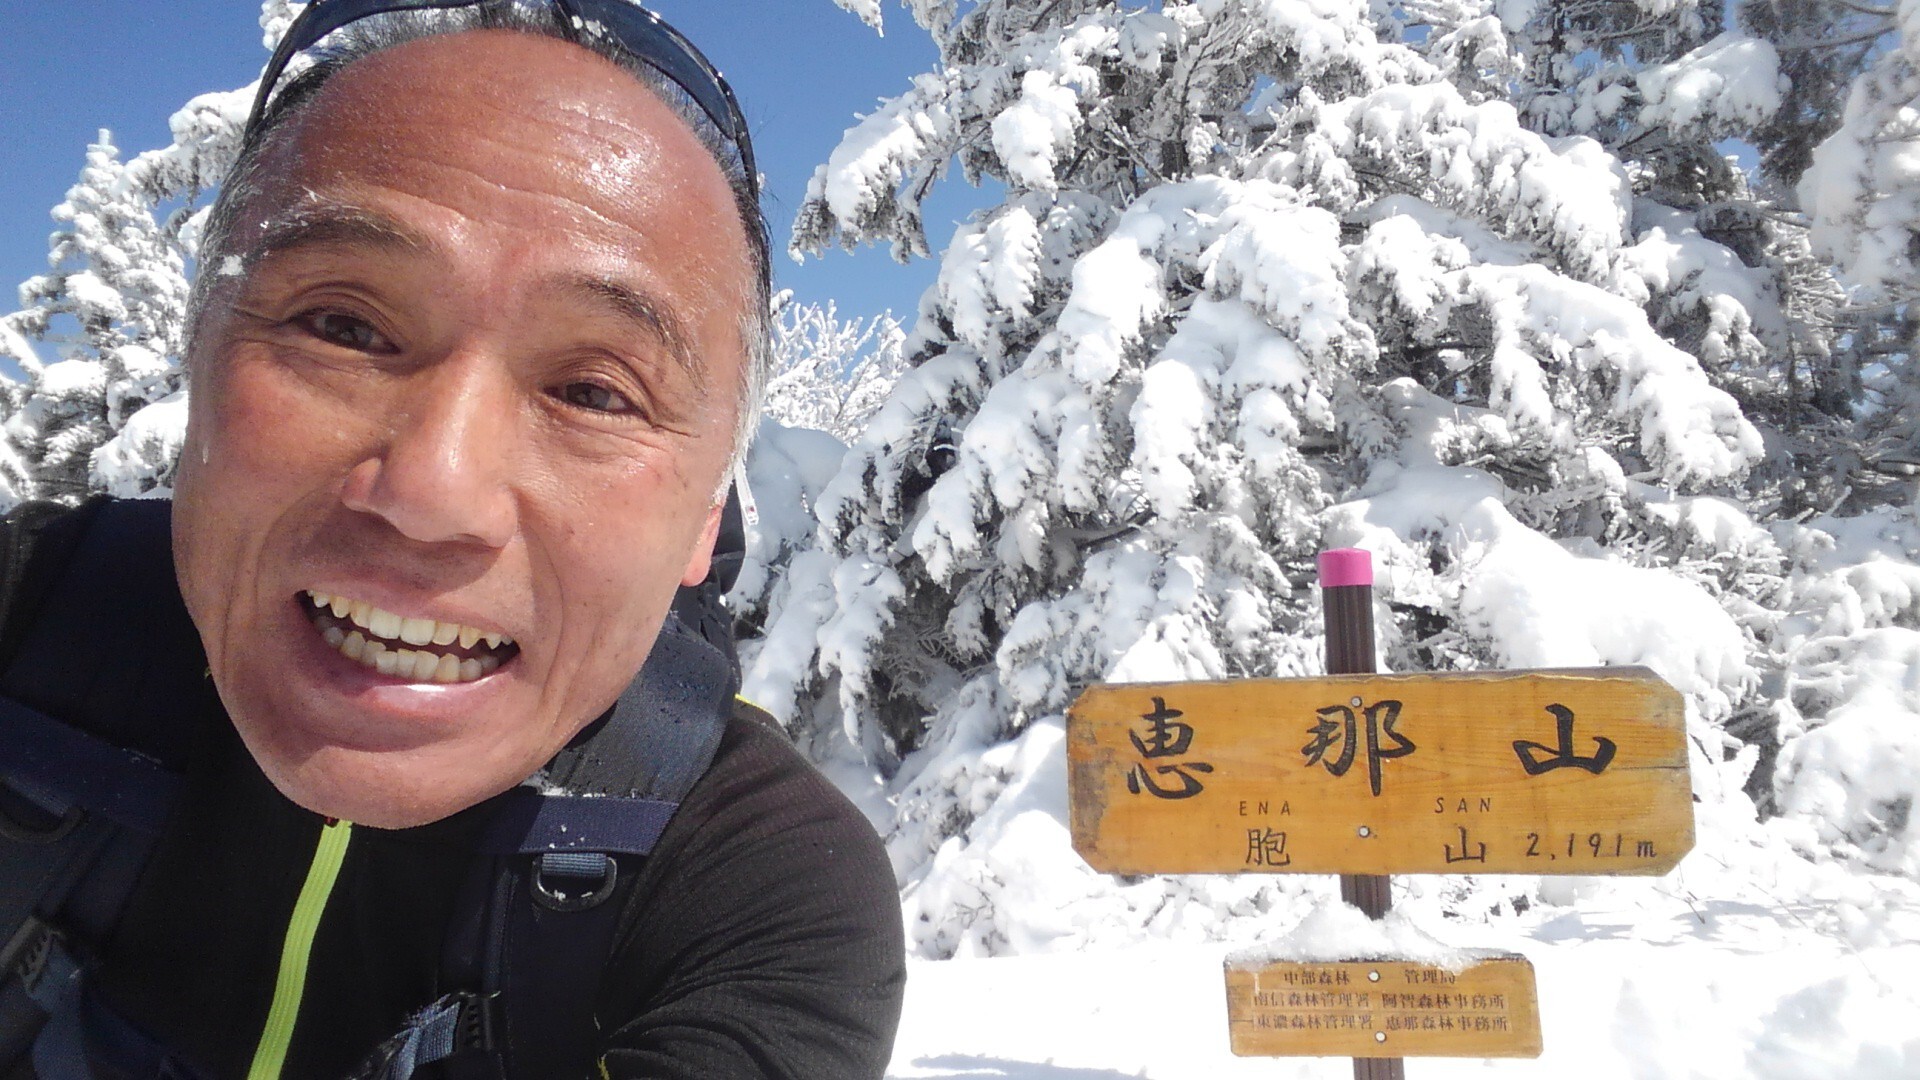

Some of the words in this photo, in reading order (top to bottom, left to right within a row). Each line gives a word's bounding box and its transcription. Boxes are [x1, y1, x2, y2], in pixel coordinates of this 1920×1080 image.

[1127, 696, 1617, 798] 恵那山
[1239, 800, 1291, 816] ENA
[1435, 797, 1491, 814] SAN
[1525, 832, 1657, 860] 2,191m
